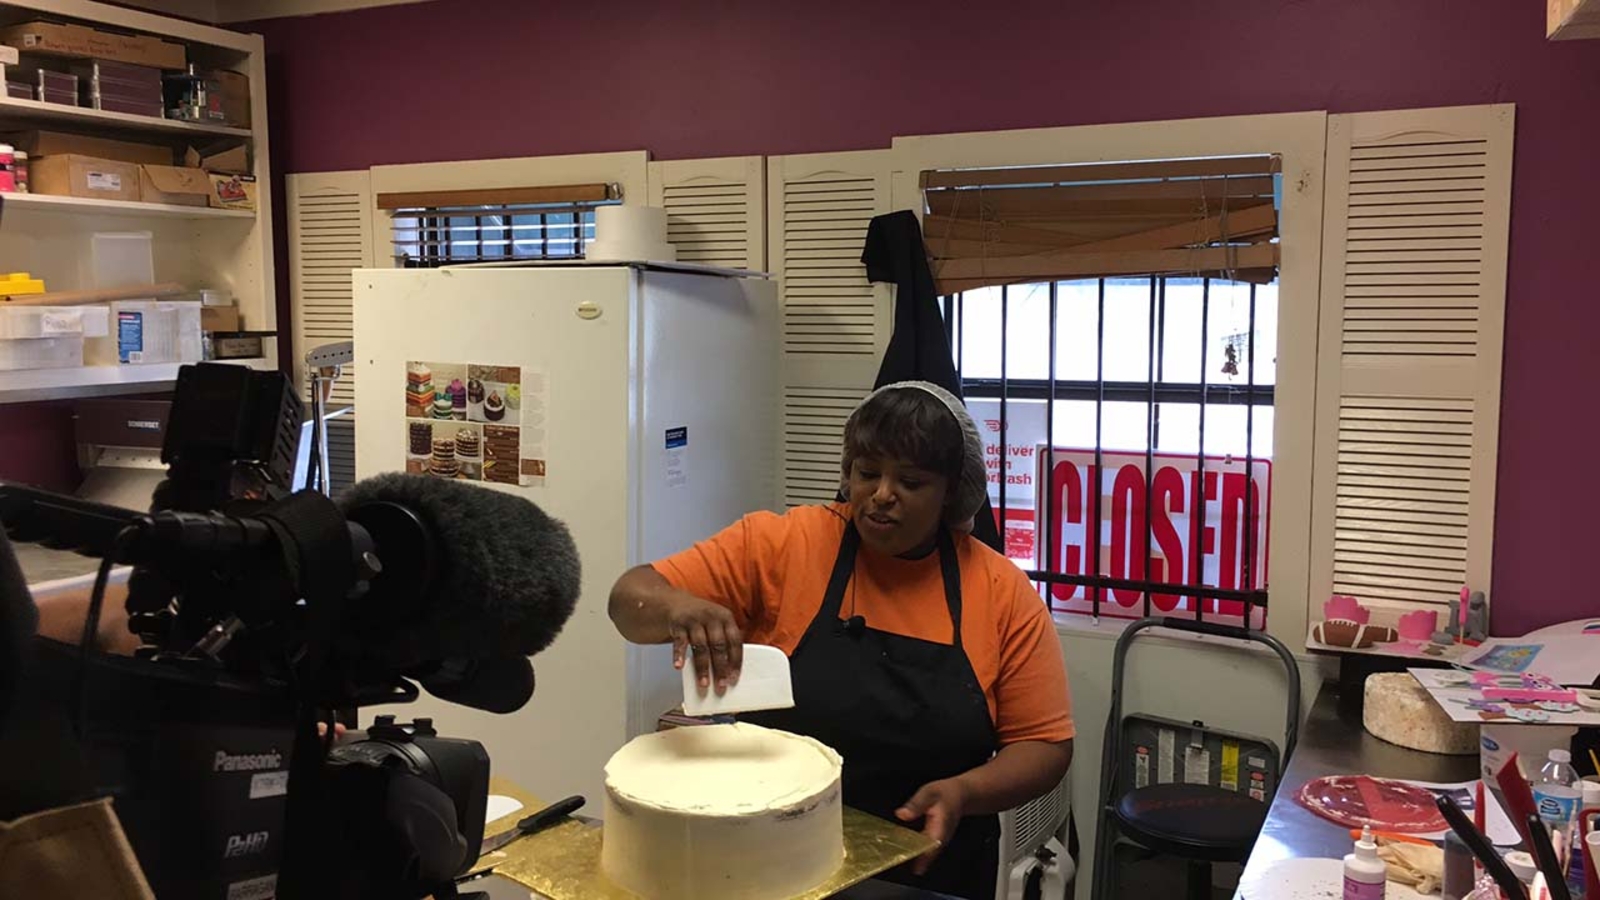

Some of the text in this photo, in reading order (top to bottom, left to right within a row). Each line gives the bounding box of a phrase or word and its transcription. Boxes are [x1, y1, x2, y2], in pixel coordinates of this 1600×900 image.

[986, 444, 1035, 457] deiver
[1049, 460, 1260, 617] CLOSED
[214, 749, 282, 771] Panasonic
